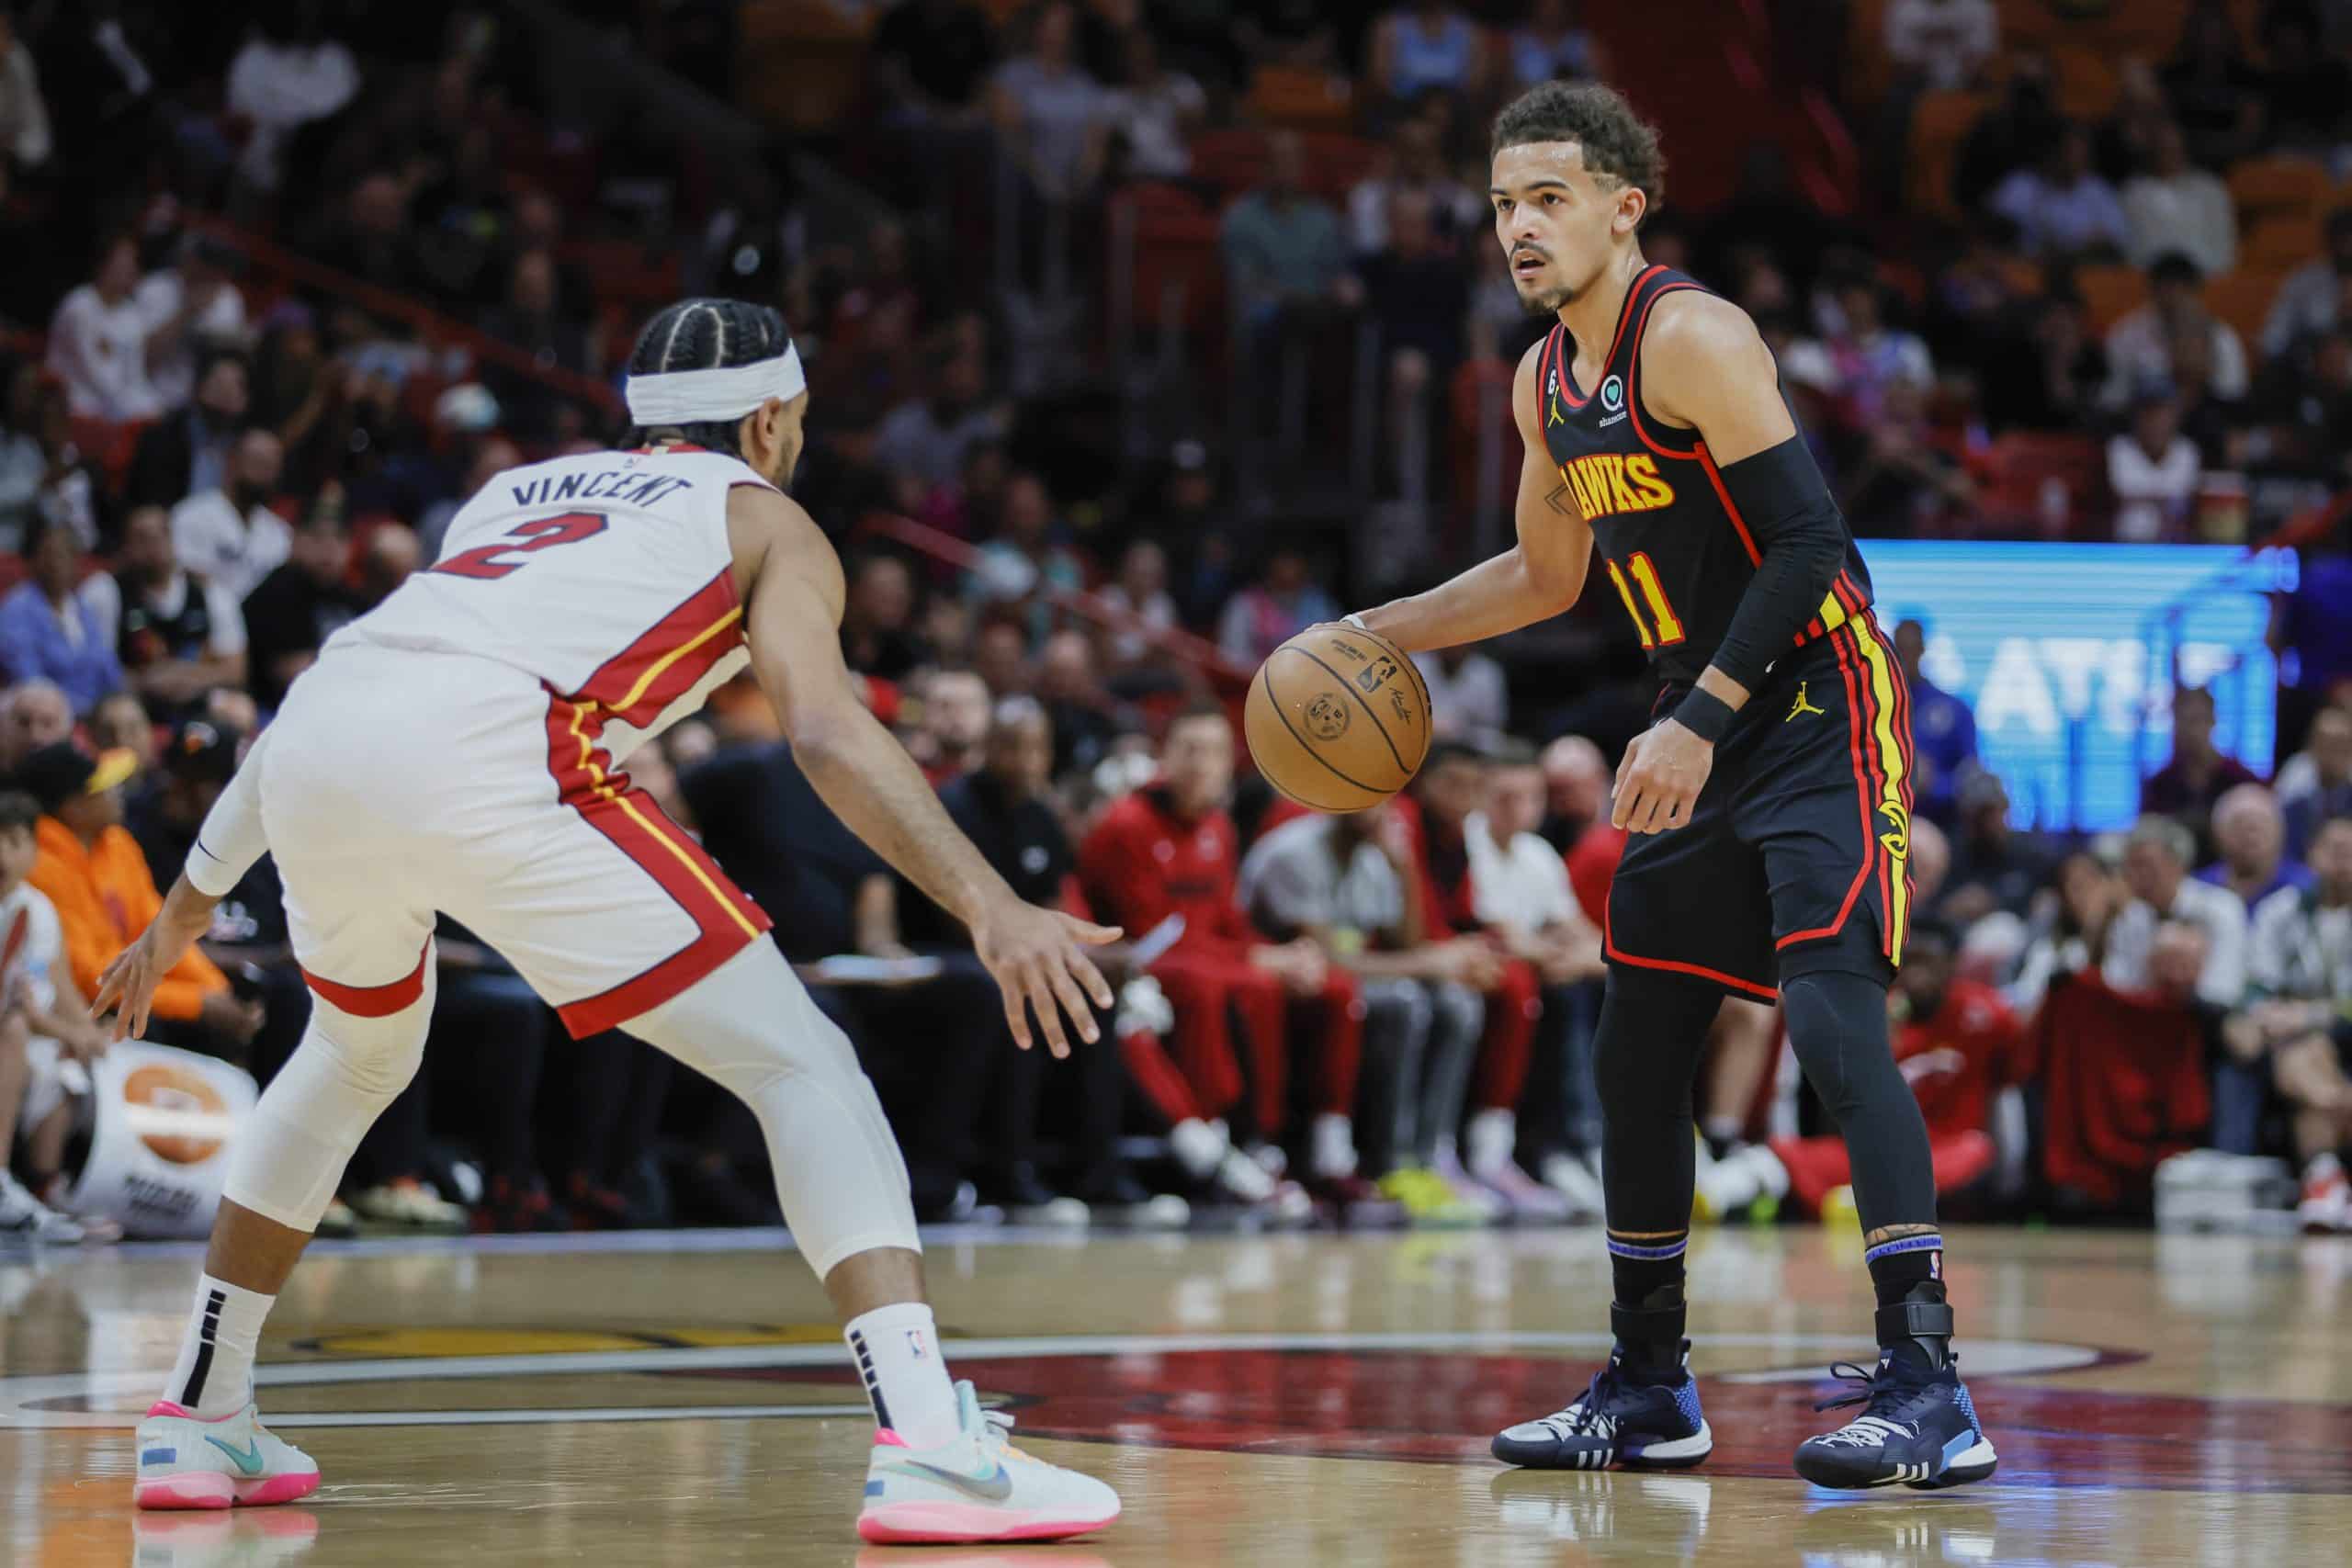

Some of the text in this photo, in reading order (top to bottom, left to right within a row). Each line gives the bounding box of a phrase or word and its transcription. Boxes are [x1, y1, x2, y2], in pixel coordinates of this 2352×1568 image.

[1548, 369, 1557, 395] 6
[512, 471, 693, 507] VINCENT
[428, 511, 609, 580] 2
[1607, 551, 1686, 649] 11
